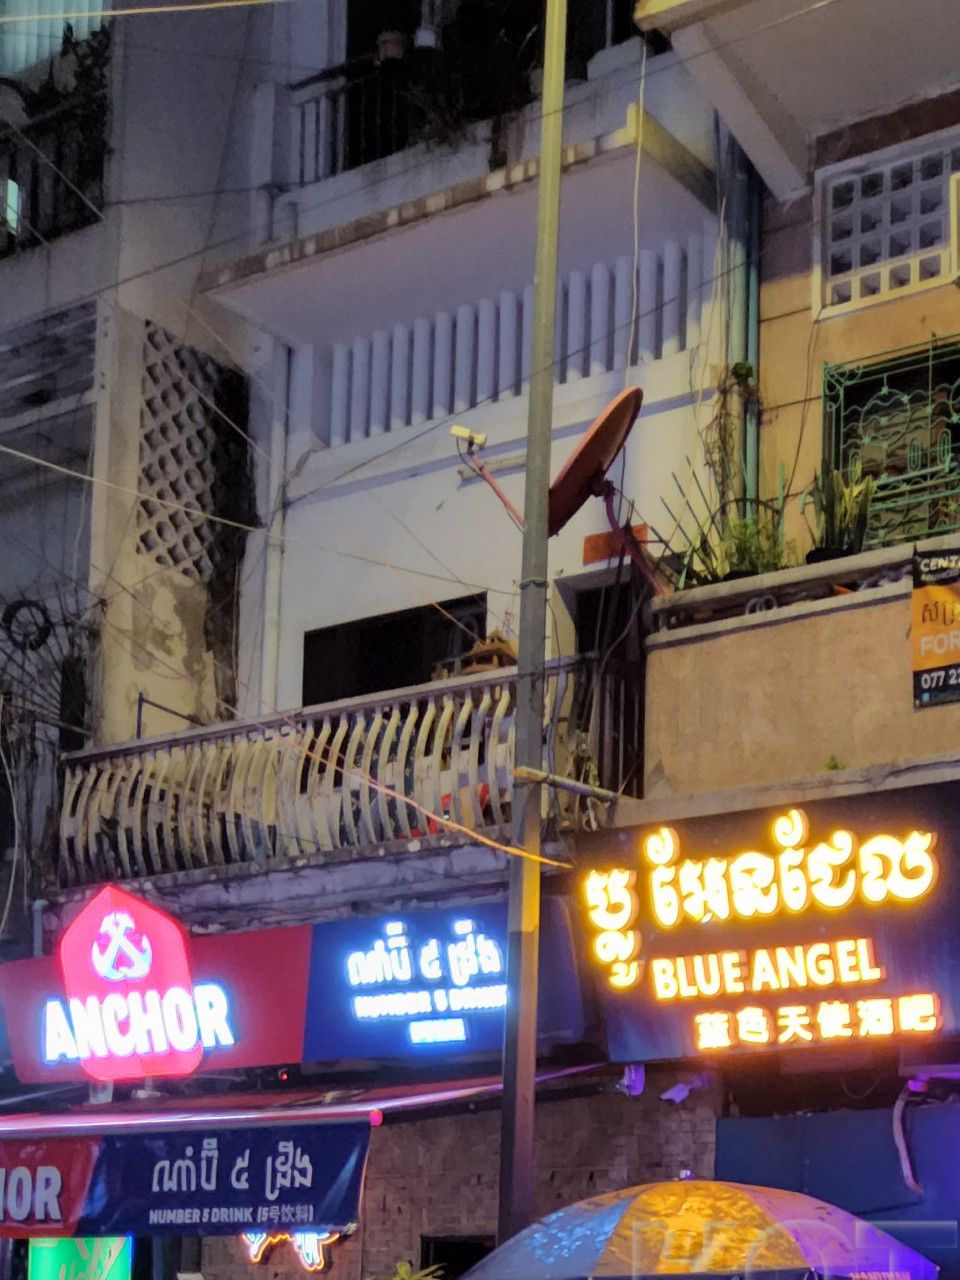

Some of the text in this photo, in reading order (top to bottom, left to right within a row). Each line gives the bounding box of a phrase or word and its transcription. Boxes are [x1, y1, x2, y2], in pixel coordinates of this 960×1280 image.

[921, 671, 945, 690] 077
[652, 937, 882, 1000] BLUE ANGEL
[45, 983, 235, 1061] ANCHOR
[0, 1165, 62, 1222] OR
[149, 1208, 200, 1225] NUMBER
[201, 1208, 211, 1223] 5
[211, 1207, 253, 1223] DRINK
